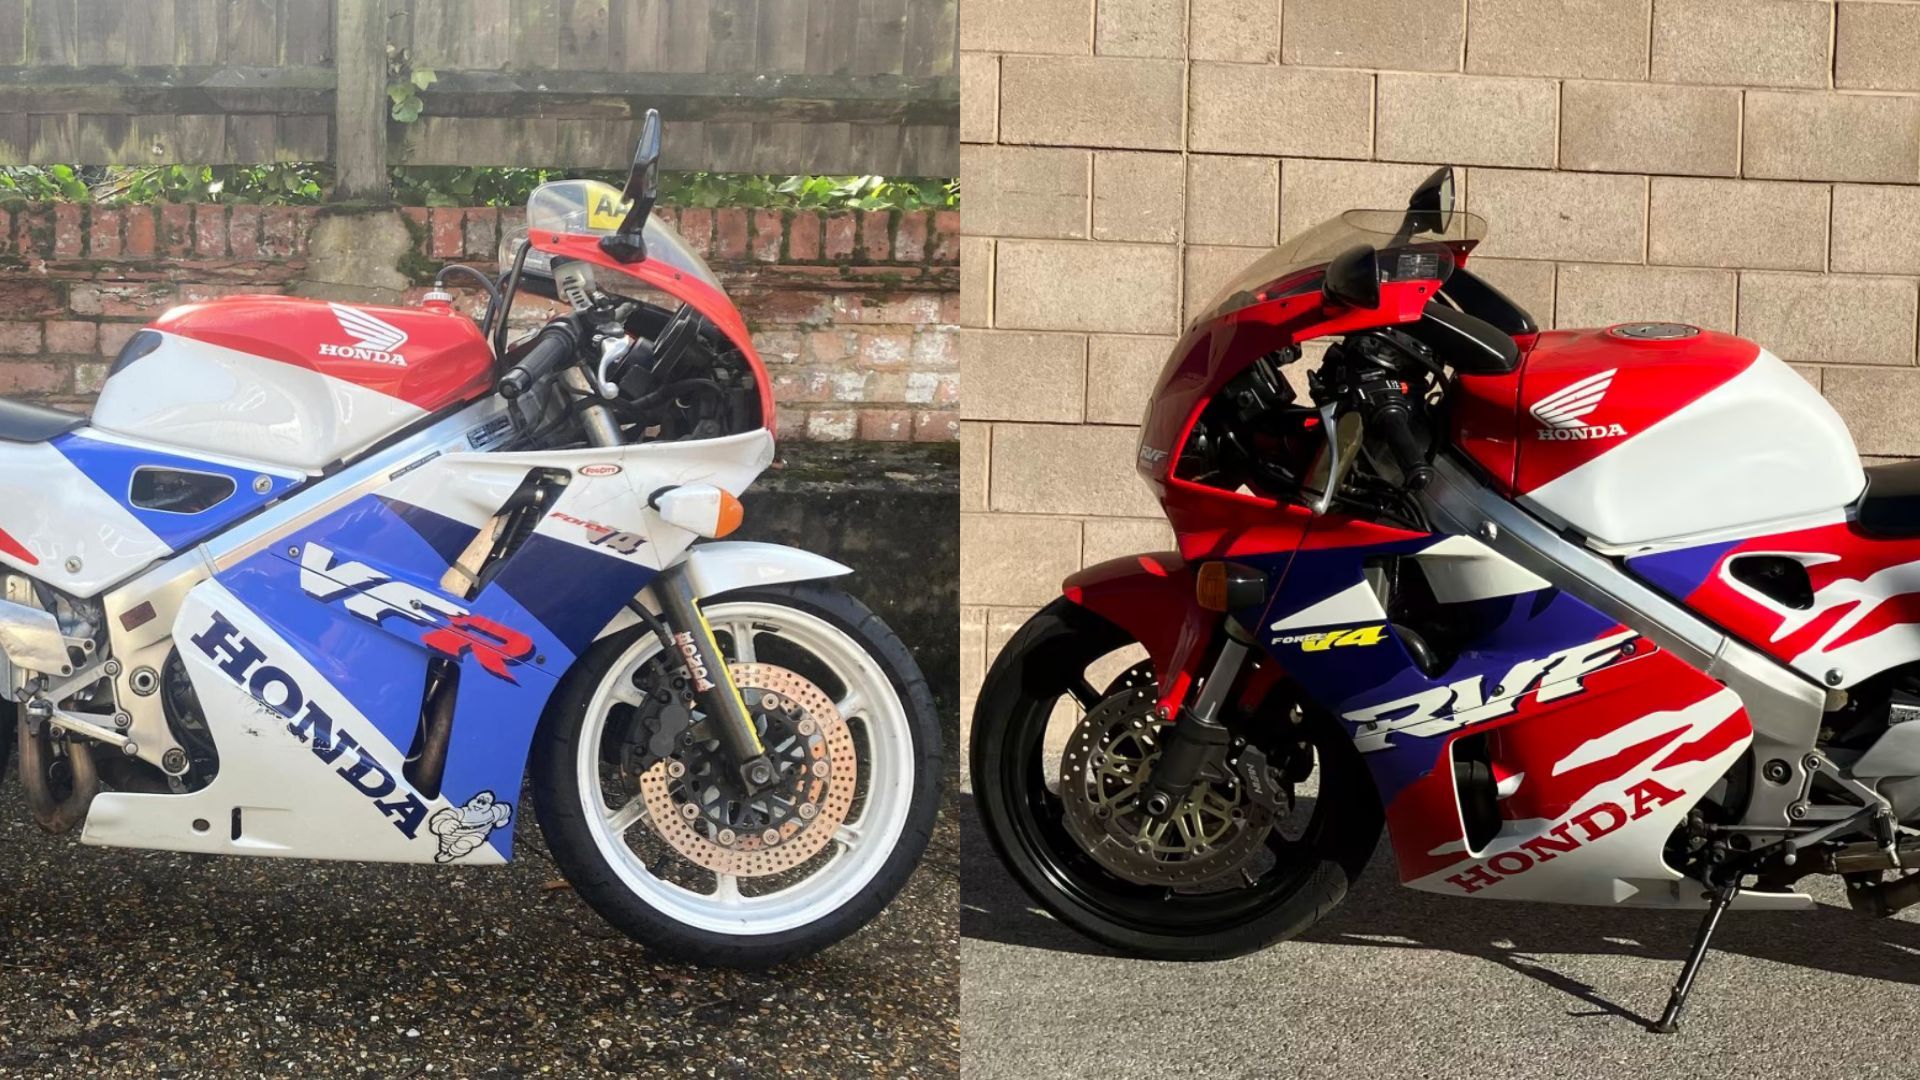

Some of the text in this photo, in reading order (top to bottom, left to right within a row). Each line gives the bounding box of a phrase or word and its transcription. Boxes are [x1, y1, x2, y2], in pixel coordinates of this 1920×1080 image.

[318, 344, 407, 367] HONDA
[1537, 423, 1628, 441] HONDA
[300, 541, 536, 688] VFR
[1302, 625, 1389, 652] V4
[674, 631, 715, 692] HONDA
[1341, 629, 1641, 754] RVF
[190, 609, 430, 841] HONDA
[1444, 778, 1687, 894] HONDA
